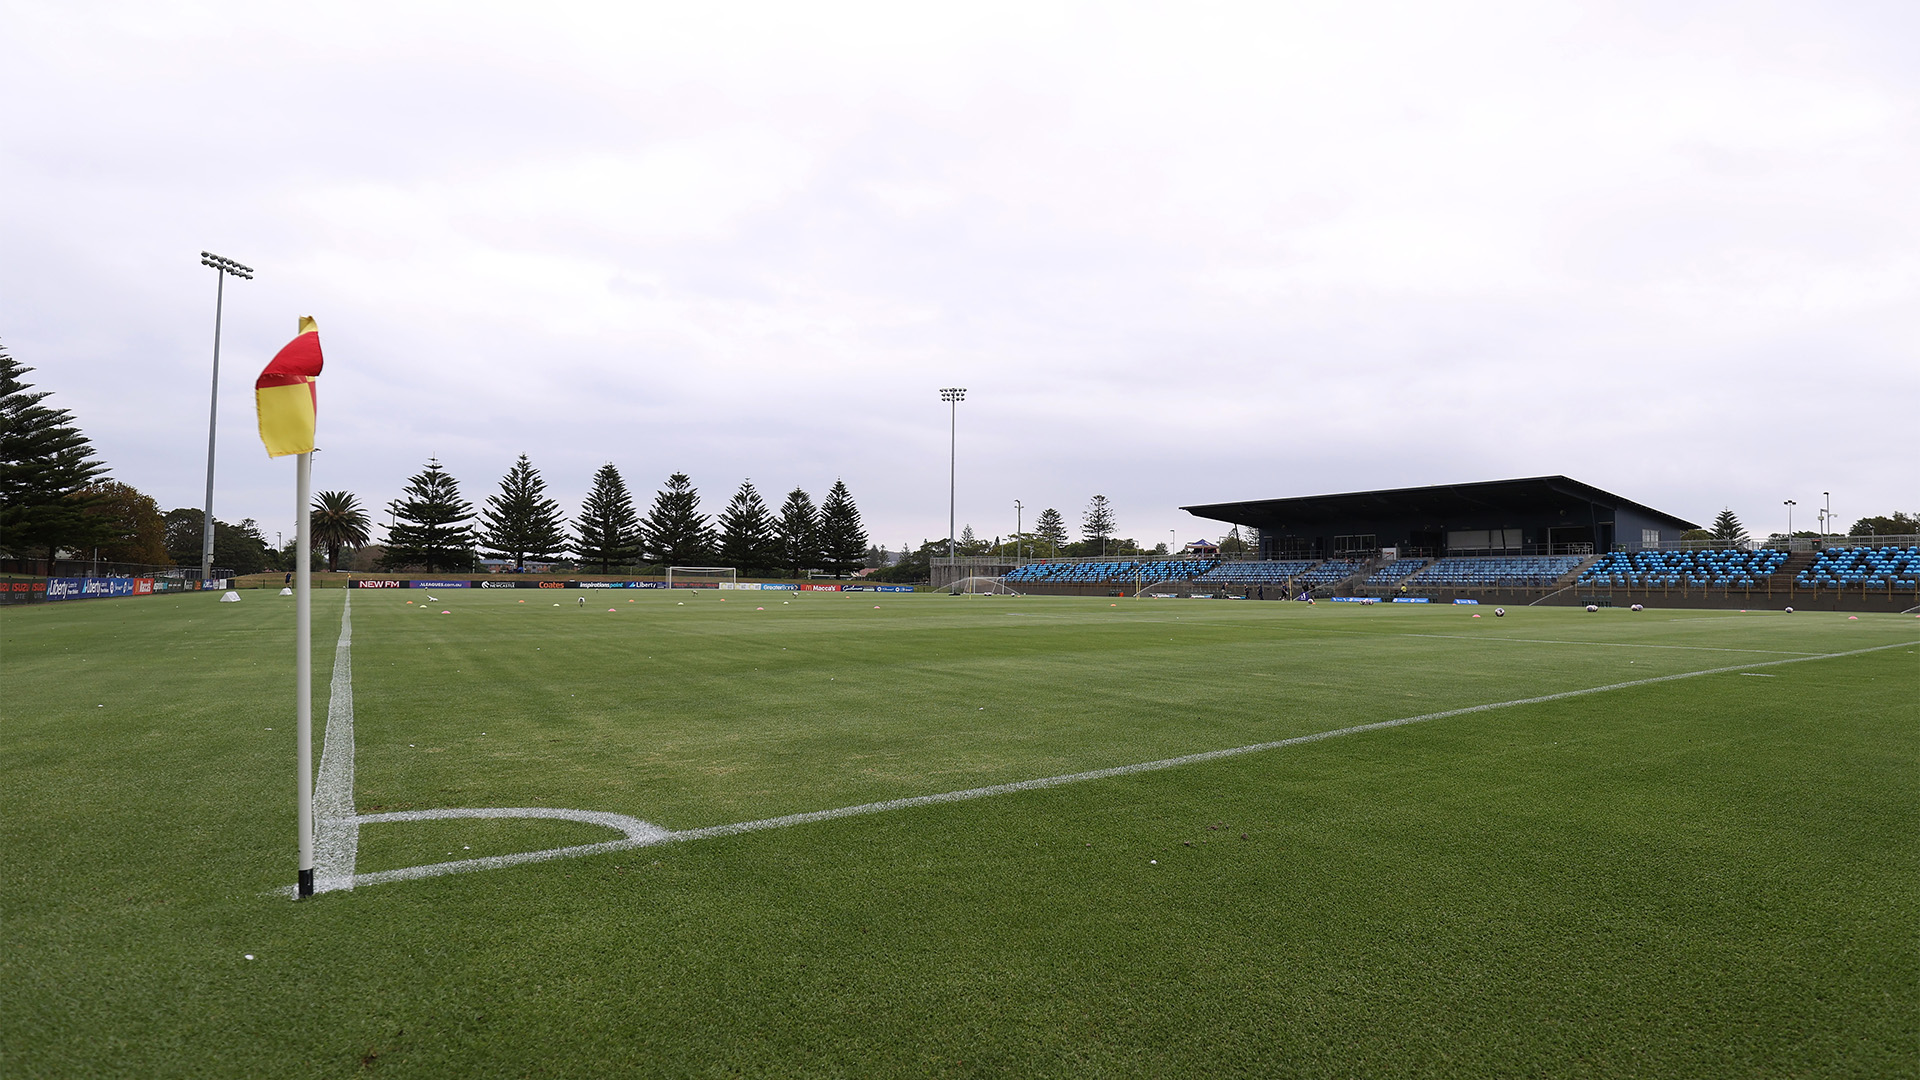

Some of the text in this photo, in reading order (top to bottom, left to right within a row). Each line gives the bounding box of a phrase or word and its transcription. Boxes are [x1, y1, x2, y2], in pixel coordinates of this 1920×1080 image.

[359, 580, 400, 588] NEW FM
[538, 581, 565, 589] Coates
[50, 579, 68, 599] Liberty
